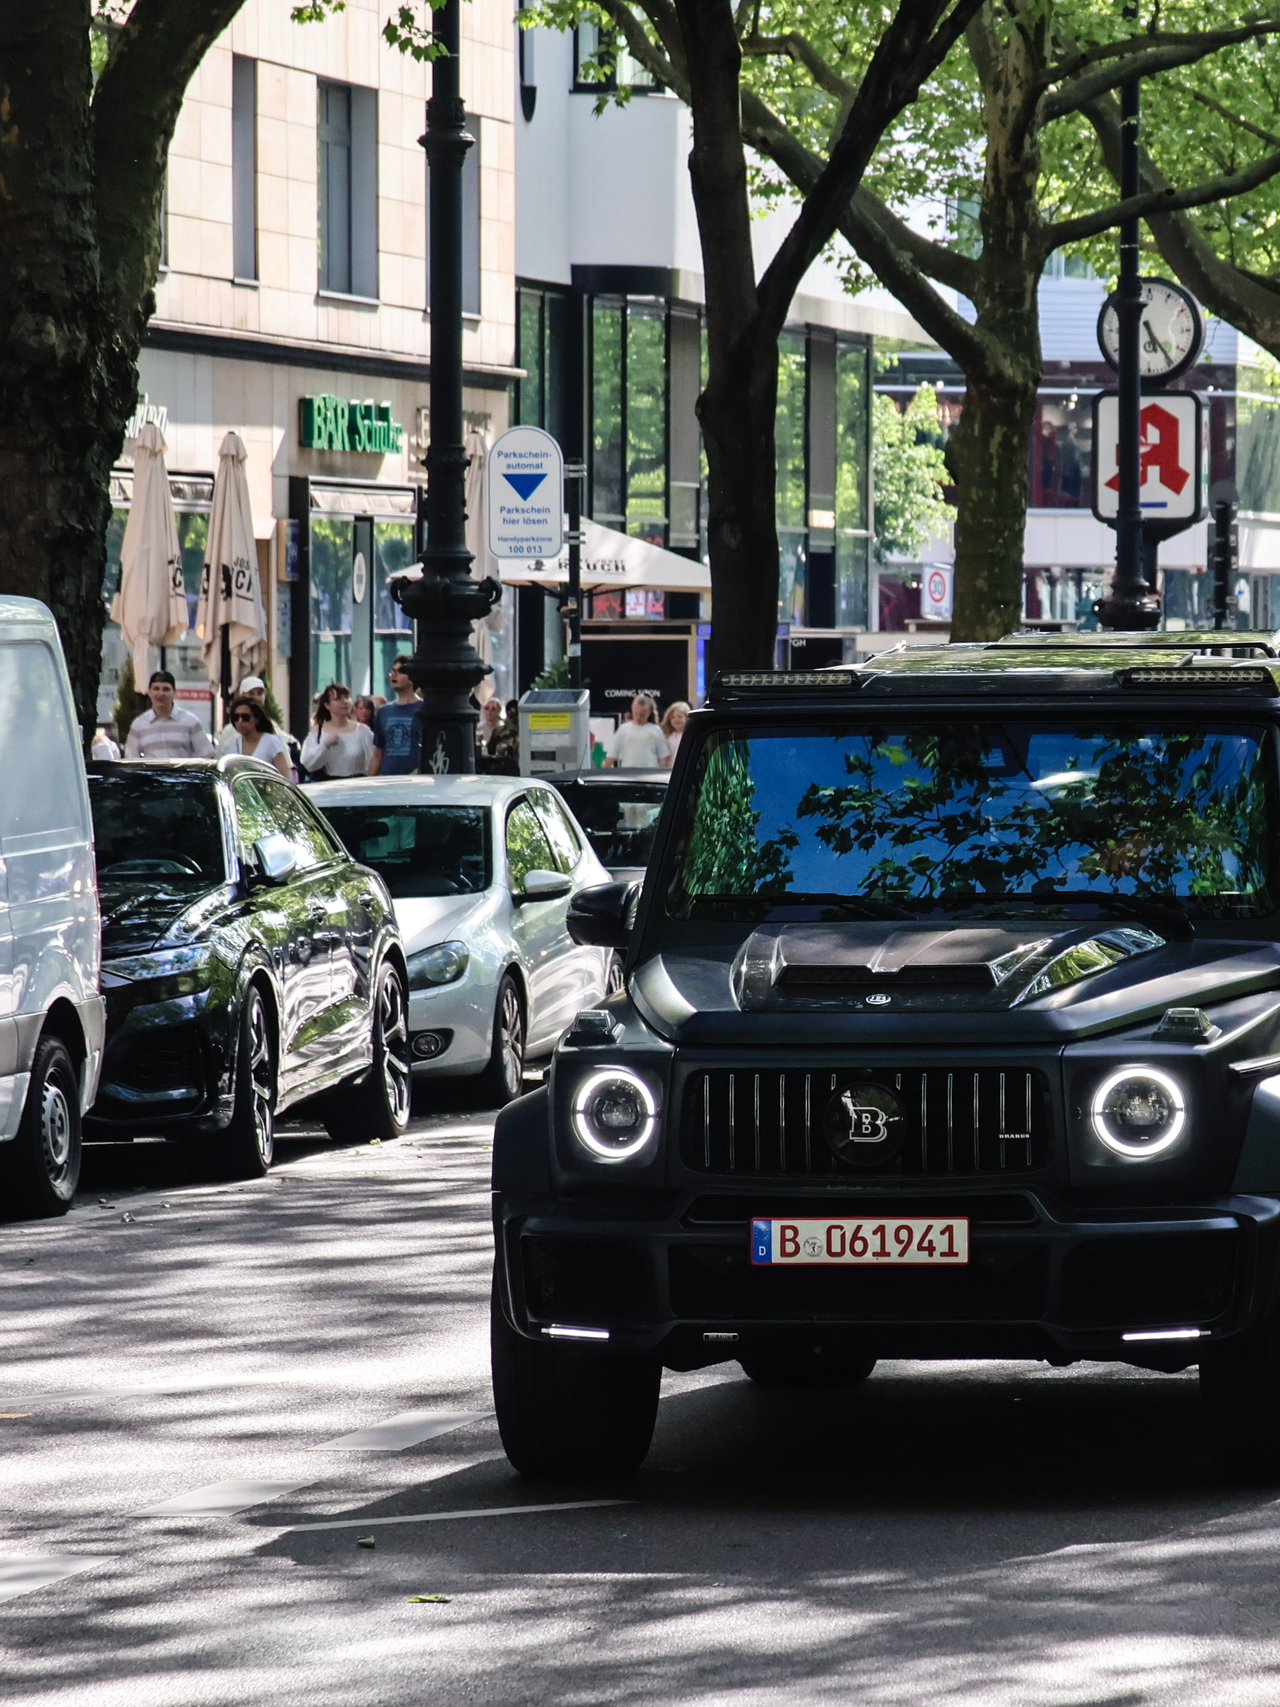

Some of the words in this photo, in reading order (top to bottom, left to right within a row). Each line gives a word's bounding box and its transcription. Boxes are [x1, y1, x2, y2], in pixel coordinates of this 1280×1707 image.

[313, 395, 350, 451] BÄR
[497, 451, 552, 459] Parkschein-
[506, 462, 543, 470] automat
[500, 506, 551, 514] Parkschein
[502, 517, 520, 525] hier
[523, 517, 548, 525] lösen
[508, 545, 524, 553] 100
[526, 545, 543, 553] 013
[558, 562, 626, 572] RUCH
[932, 580, 943, 595] 30
[604, 689, 636, 698] COMING
[780, 1225, 801, 1258] B
[826, 1224, 959, 1258] 061941
